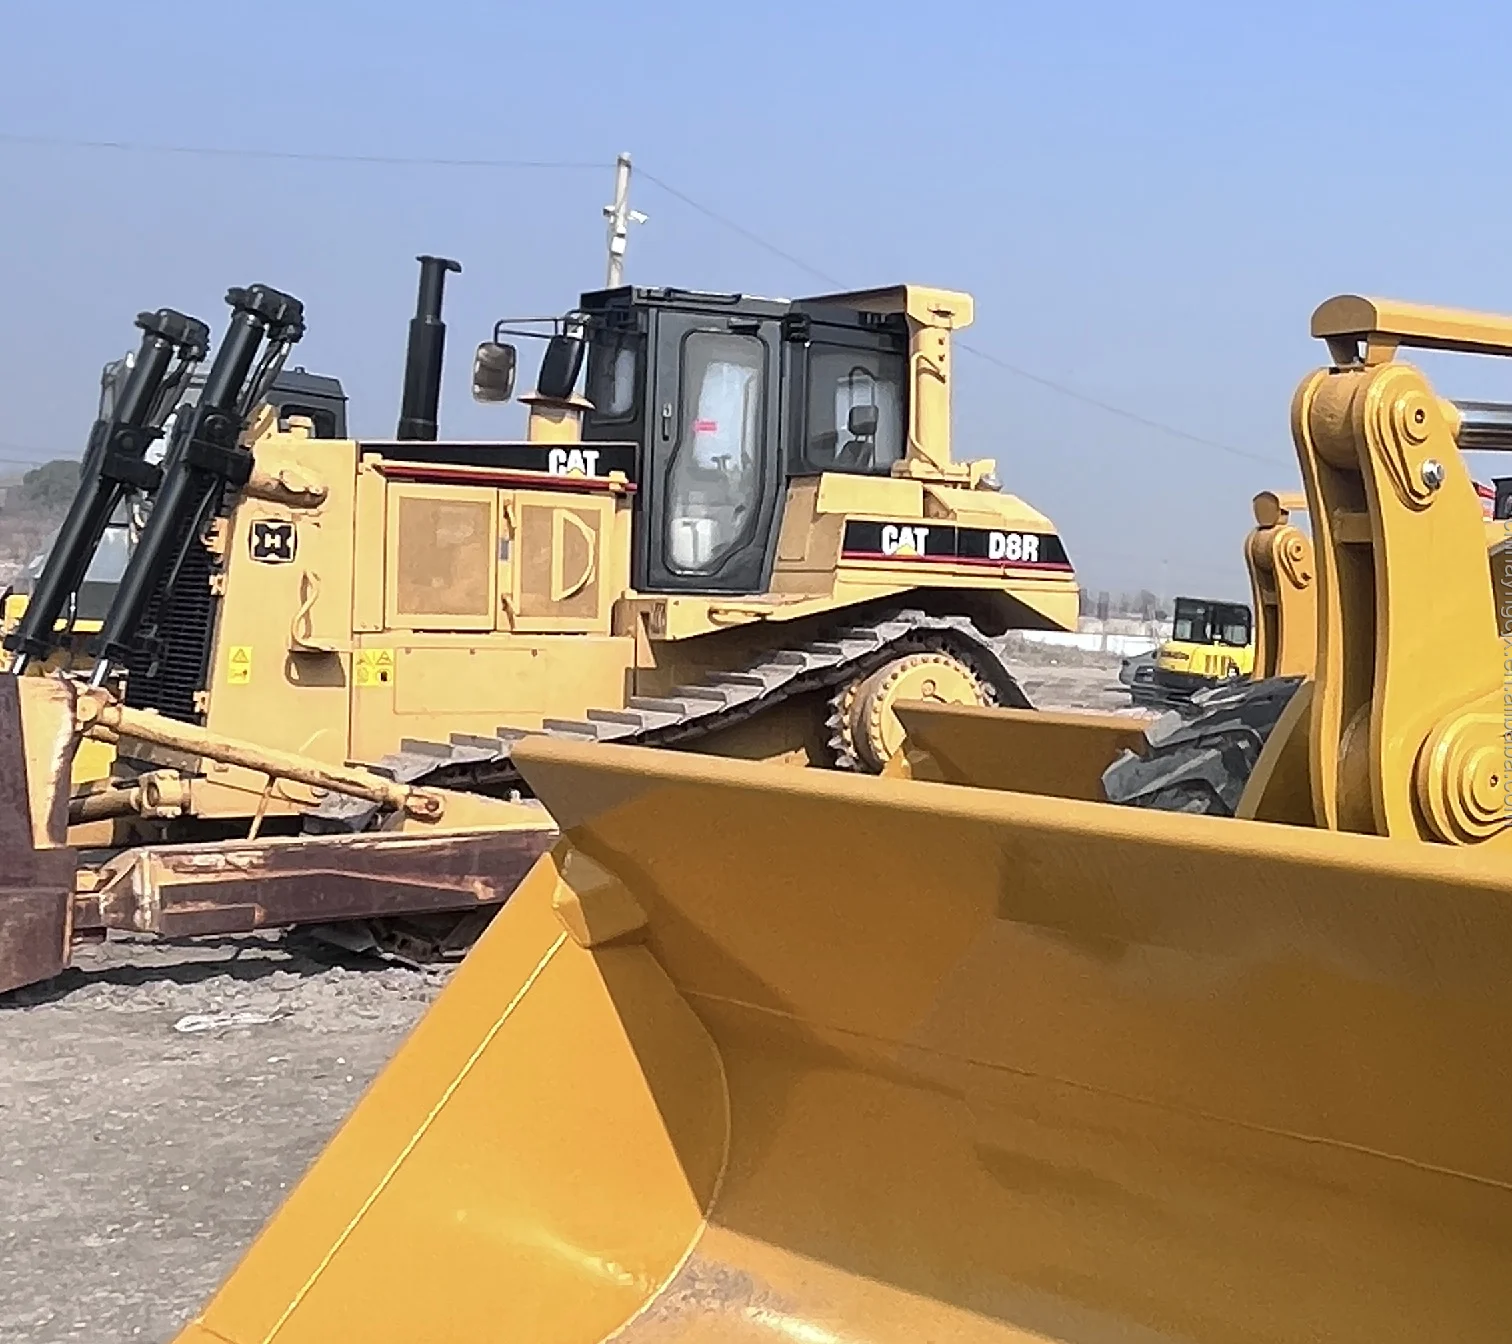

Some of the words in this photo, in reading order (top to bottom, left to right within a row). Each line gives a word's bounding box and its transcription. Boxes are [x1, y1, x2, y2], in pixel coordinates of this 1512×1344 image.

[548, 448, 600, 477] CAT
[882, 525, 929, 556] CAT
[988, 531, 1040, 562] D8R
